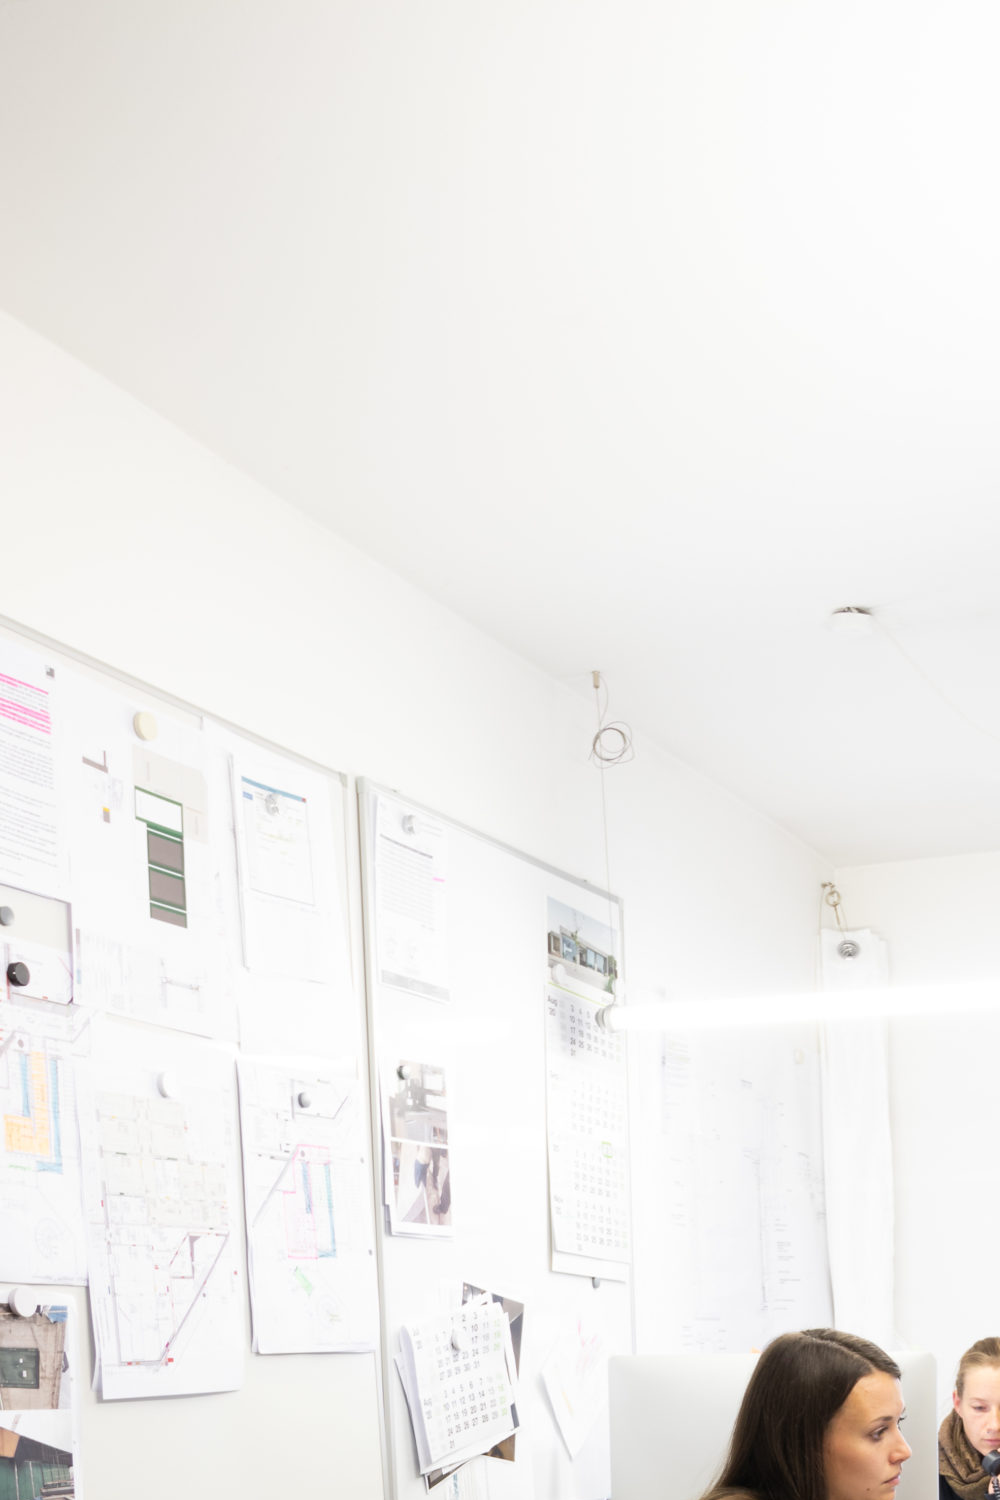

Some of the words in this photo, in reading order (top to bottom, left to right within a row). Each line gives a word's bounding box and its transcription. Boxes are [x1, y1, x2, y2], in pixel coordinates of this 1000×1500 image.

[462, 1314, 466, 1322] 2
[471, 1324, 478, 1332] 10
[472, 1335, 478, 1344] 17
[472, 1348, 479, 1357] 24
[473, 1360, 480, 1369] 31
[469, 1381, 473, 1389] 6
[479, 1390, 485, 1398] 14
[470, 1405, 477, 1414] 20
[480, 1402, 486, 1411] 21
[472, 1417, 478, 1426] 27
